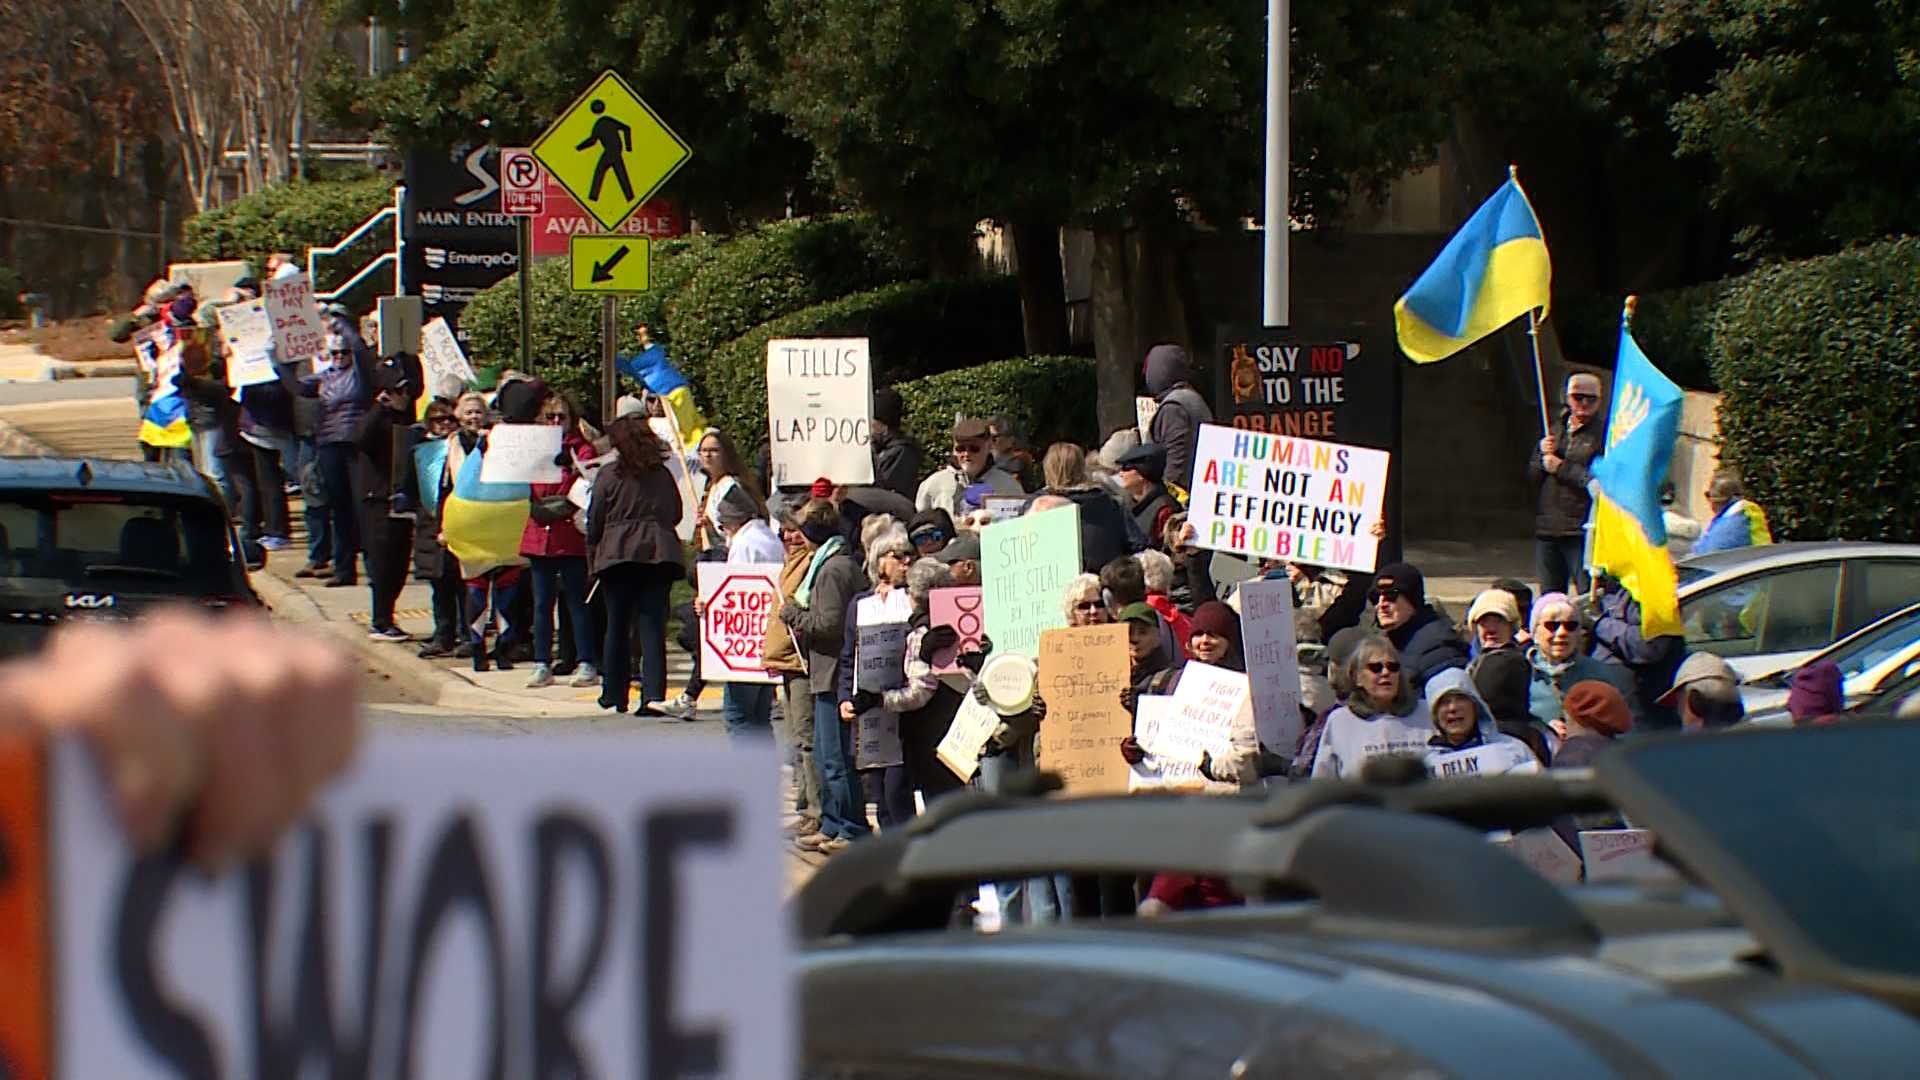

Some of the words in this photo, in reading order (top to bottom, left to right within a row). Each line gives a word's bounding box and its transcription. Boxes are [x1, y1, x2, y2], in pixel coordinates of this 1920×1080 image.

[416, 211, 460, 226] MAIN
[466, 211, 518, 226] ENTRA
[546, 217, 672, 235] AVAIBLE
[448, 251, 519, 268] EmergeOr
[783, 347, 858, 378] TILLIS
[1256, 346, 1300, 373] SAY
[1311, 347, 1343, 373] NO
[1263, 377, 1291, 404] TO
[1301, 377, 1344, 404] THE
[776, 416, 816, 443] LAP
[825, 416, 870, 446] DOG
[1233, 432, 1350, 474] HUMANS
[1203, 459, 1249, 489] ARE
[1264, 467, 1312, 498] NOT
[1329, 478, 1366, 507] AN
[1214, 491, 1363, 536] EFFICIENCY
[999, 530, 1039, 569] STOP
[1210, 520, 1355, 566] PROBLEM
[993, 571, 1018, 609] THE
[1025, 562, 1064, 597] STEAL
[722, 591, 773, 611] STOP
[713, 609, 769, 636] PROJEC
[1208, 681, 1243, 697] FIGHT
[1442, 755, 1479, 777] DELAY
